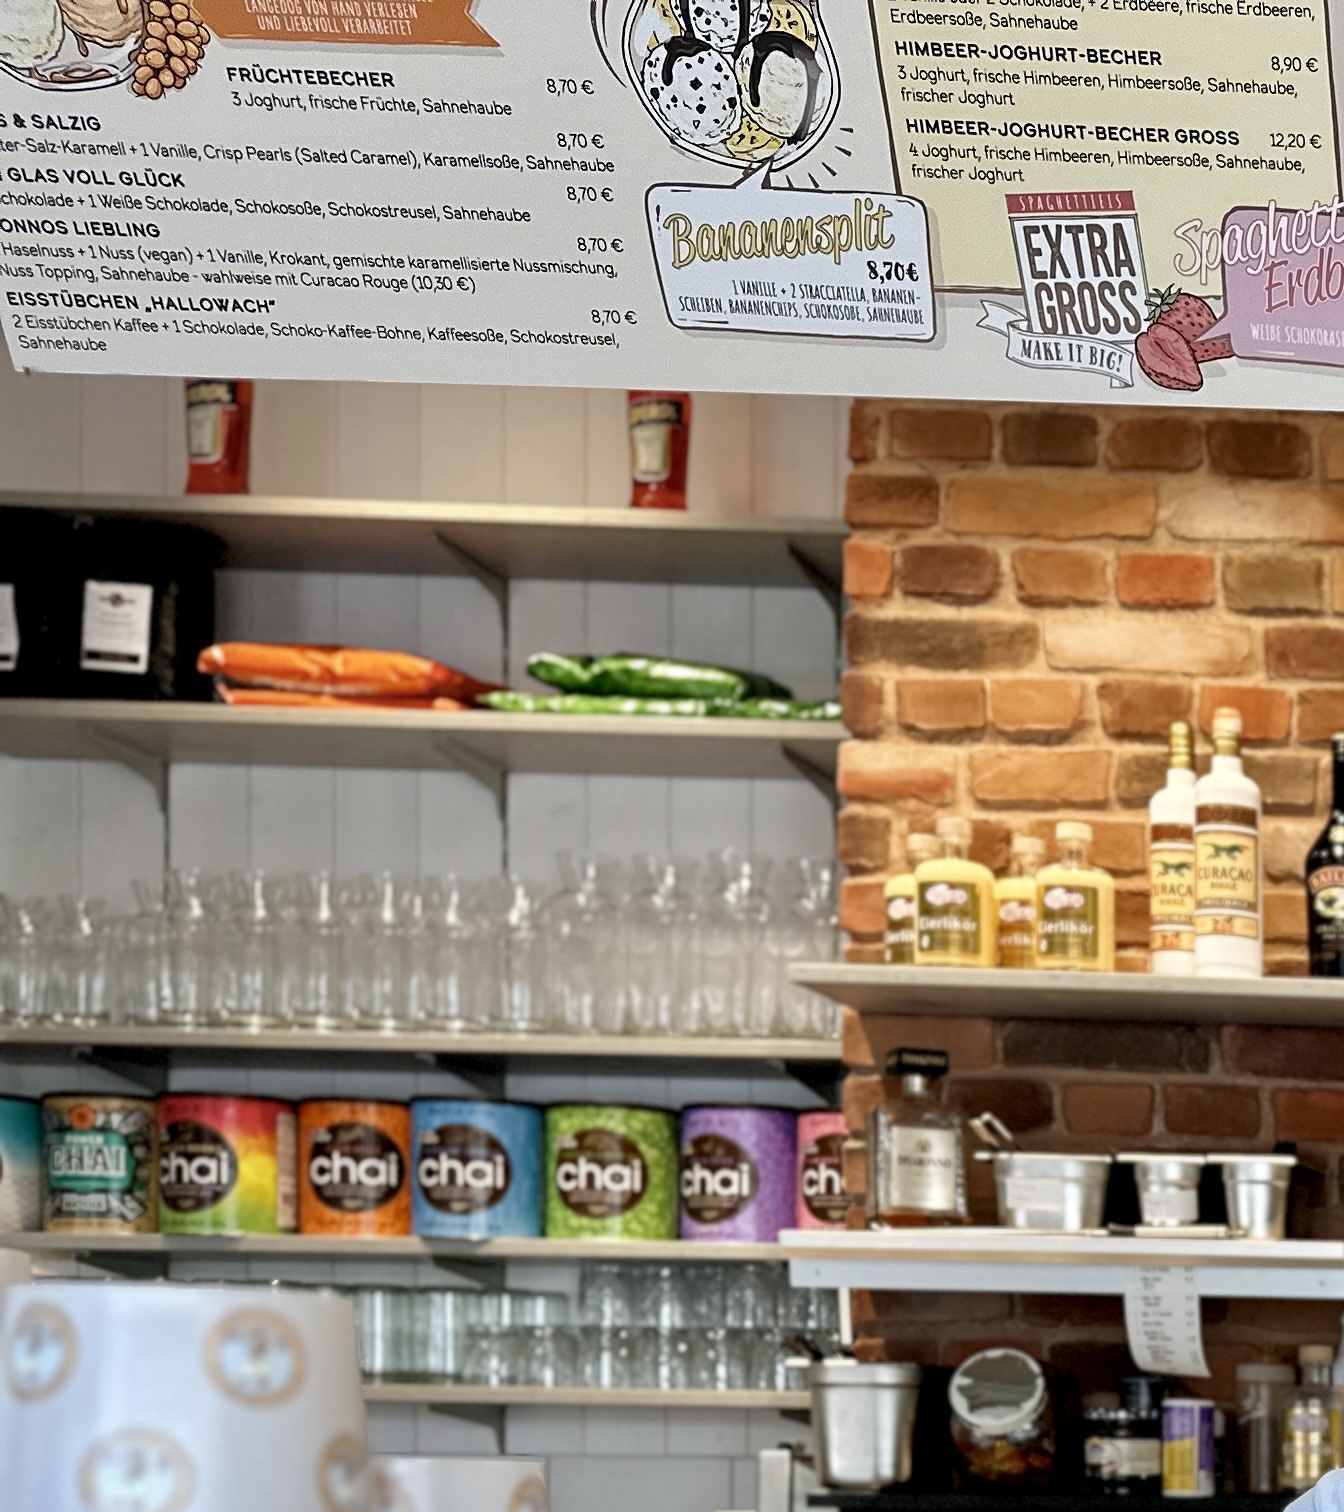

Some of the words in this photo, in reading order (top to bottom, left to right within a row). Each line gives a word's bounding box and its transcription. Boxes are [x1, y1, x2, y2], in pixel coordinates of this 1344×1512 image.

[256, 14, 281, 31] UND
[283, 15, 341, 34] LIEBEVOLL
[340, 17, 413, 36] VERARBEITET
[894, 40, 1163, 66] HIMBEER-JOGHURT-BECHER
[1270, 56, 1302, 75] 8,90
[1305, 57, 1319, 73] €
[226, 66, 396, 88] FRÜCHTEBECHER
[546, 78, 578, 95] 8,70
[580, 79, 595, 95] €
[230, 91, 242, 107] 3
[244, 92, 307, 112] Joghurt,
[308, 93, 358, 111] frische
[359, 95, 420, 116] Früchte,
[422, 97, 512, 116] Sahnehaube
[900, 86, 955, 104] frischer
[957, 89, 1016, 109] Joghurt
[905, 118, 1170, 143] HIMBEER-JOGHURT-BECHER
[1174, 128, 1240, 146] GROSS
[1269, 132, 1306, 149] 12,20
[1309, 134, 1322, 149] €
[6, 167, 60, 184] GLAS
[62, 169, 116, 186] VOLL
[118, 171, 186, 188] GLÜCK
[1019, 193, 1122, 211] SPAGHETTIEIS
[663, 198, 895, 270] Bananensplit
[1023, 222, 1137, 279] EXTRA
[866, 260, 920, 284] 8,70€
[5, 289, 140, 310] EISSTÜBCHEN
[1034, 279, 1142, 336] GROSS
[18, 335, 108, 352] Sahnehaube
[1020, 337, 1064, 362] MAKE
[1068, 342, 1084, 363] IT
[1088, 349, 1123, 373] BIG!
[160, 1150, 229, 1185] chai
[309, 1151, 400, 1187] chai
[417, 1152, 505, 1189] chai
[555, 1156, 643, 1194] chai
[681, 1162, 750, 1197] chai
